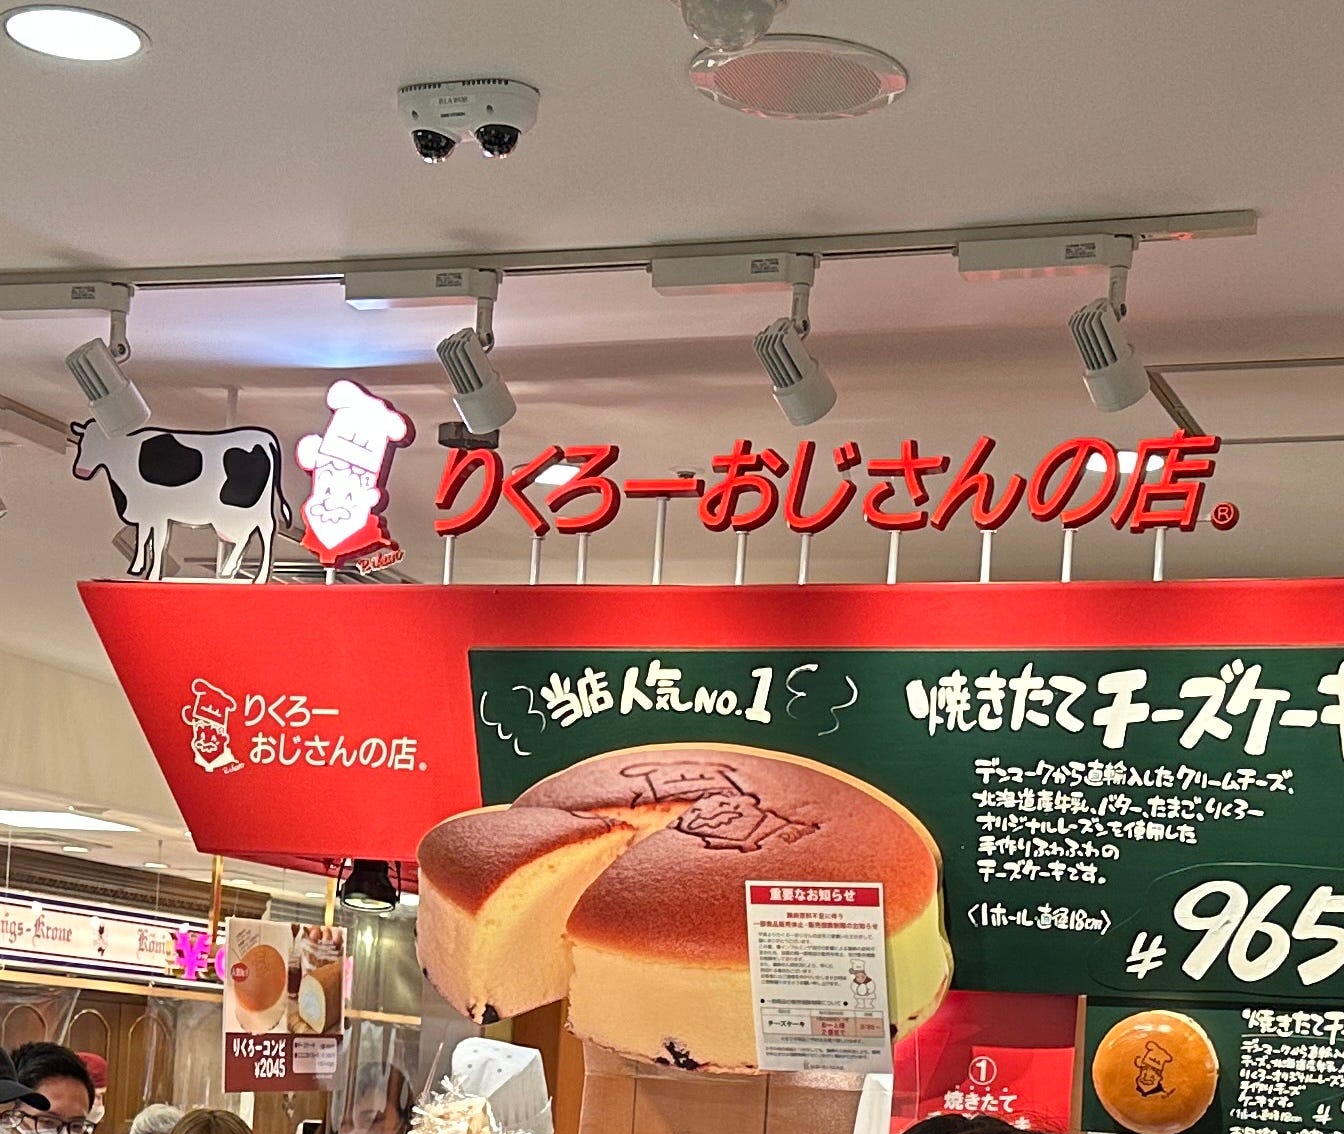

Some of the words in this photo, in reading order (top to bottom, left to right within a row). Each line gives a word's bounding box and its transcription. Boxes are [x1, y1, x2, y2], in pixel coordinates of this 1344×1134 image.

[243, 693, 340, 728] りくろー
[975, 812, 1198, 845] オリジナルレーズンを使用した
[976, 836, 1121, 861] 手作りふわふわの
[976, 859, 1107, 885] チーズケーキです。
[769, 887, 857, 903] 重要なお知らせ
[767, 1019, 806, 1028] チーズケーキ
[232, 1037, 287, 1059] りくろーコンビ
[943, 1089, 1018, 1113] 焼きたて
